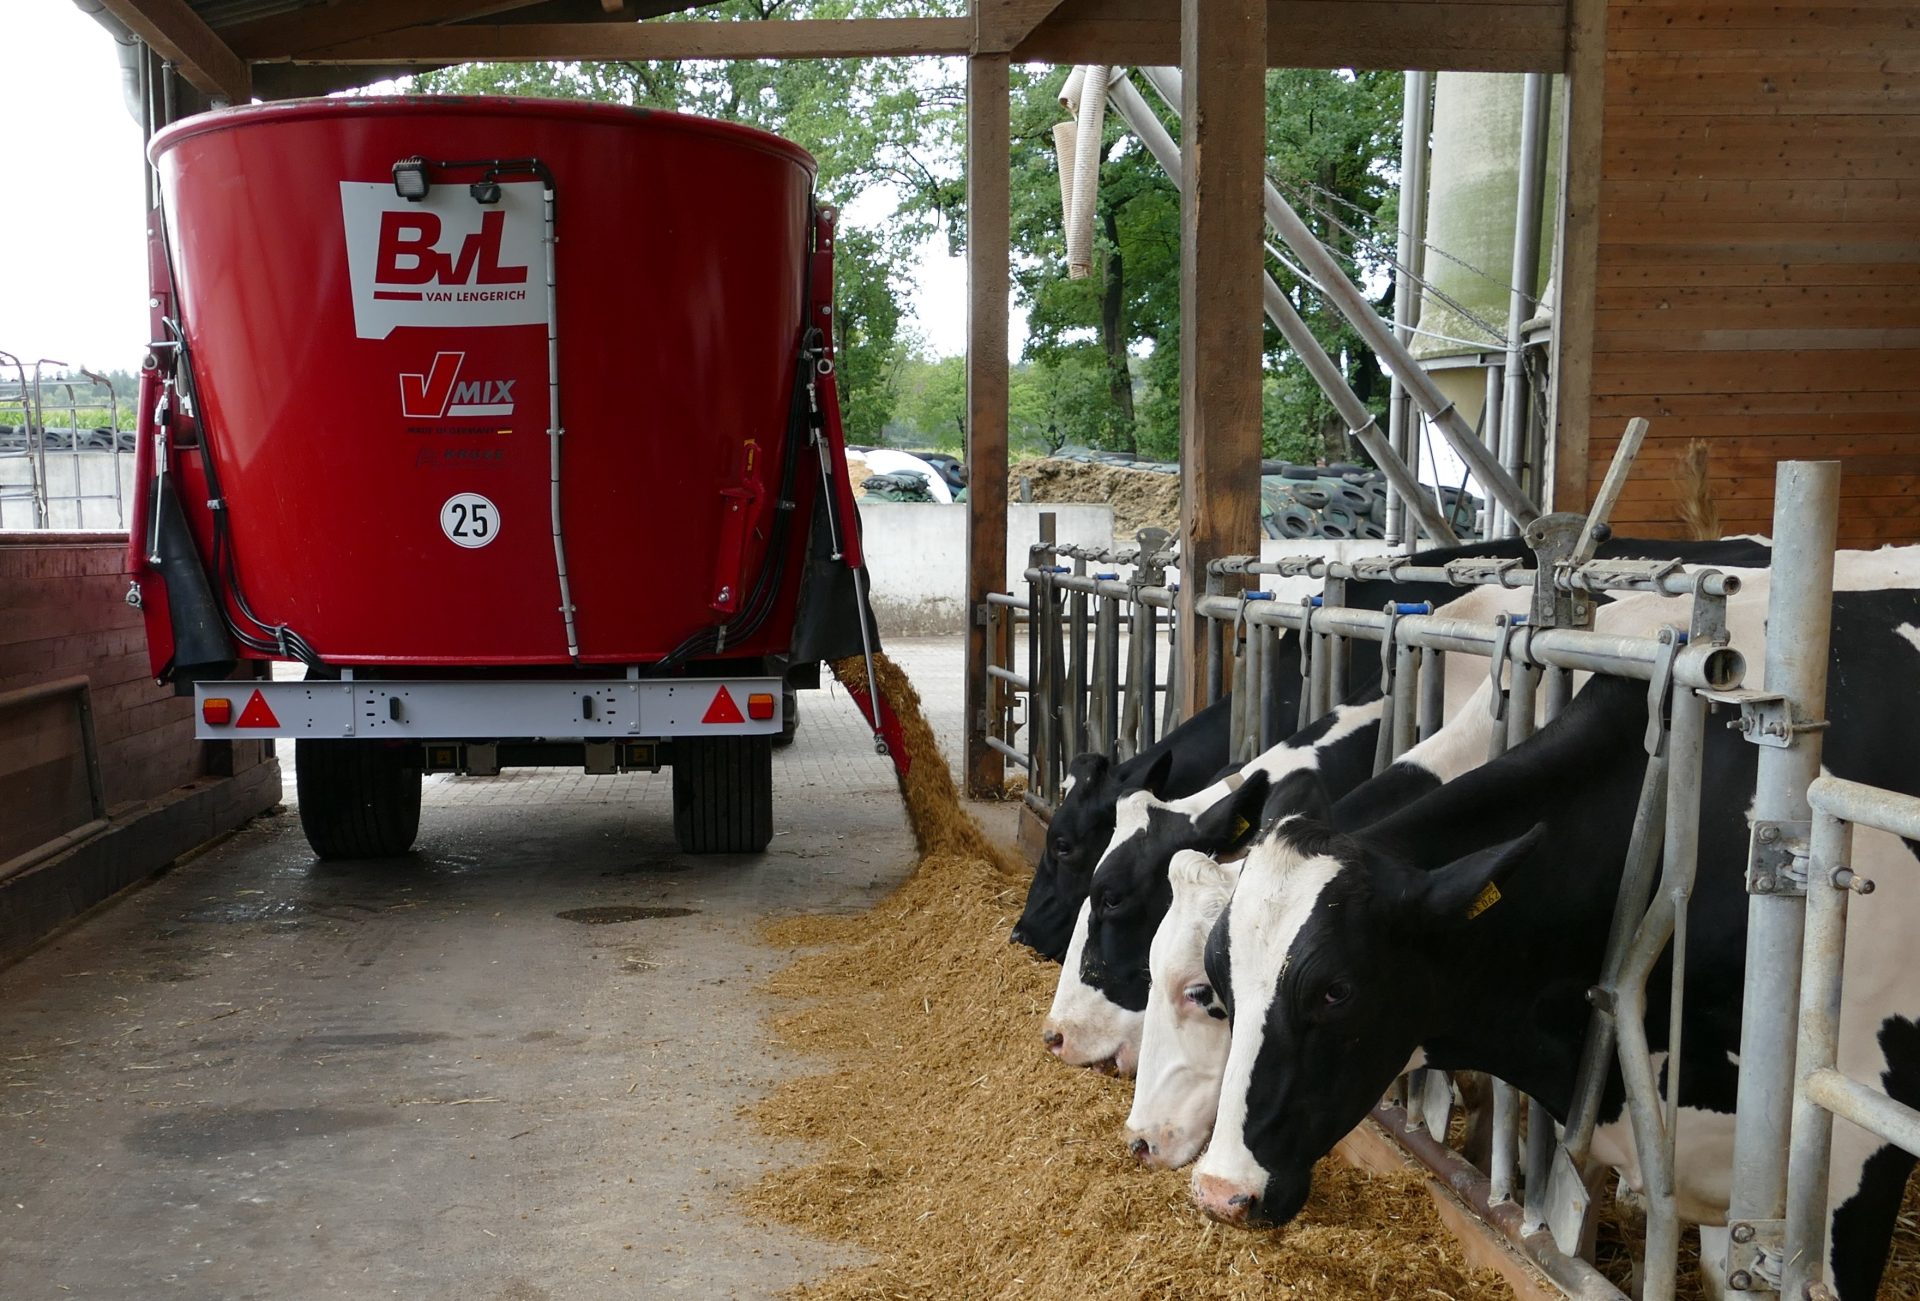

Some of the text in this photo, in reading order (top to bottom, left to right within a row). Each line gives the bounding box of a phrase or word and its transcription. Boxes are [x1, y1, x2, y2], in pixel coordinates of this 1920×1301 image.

[426, 290, 526, 302] VAN LENGERICH
[451, 503, 488, 538] 25
